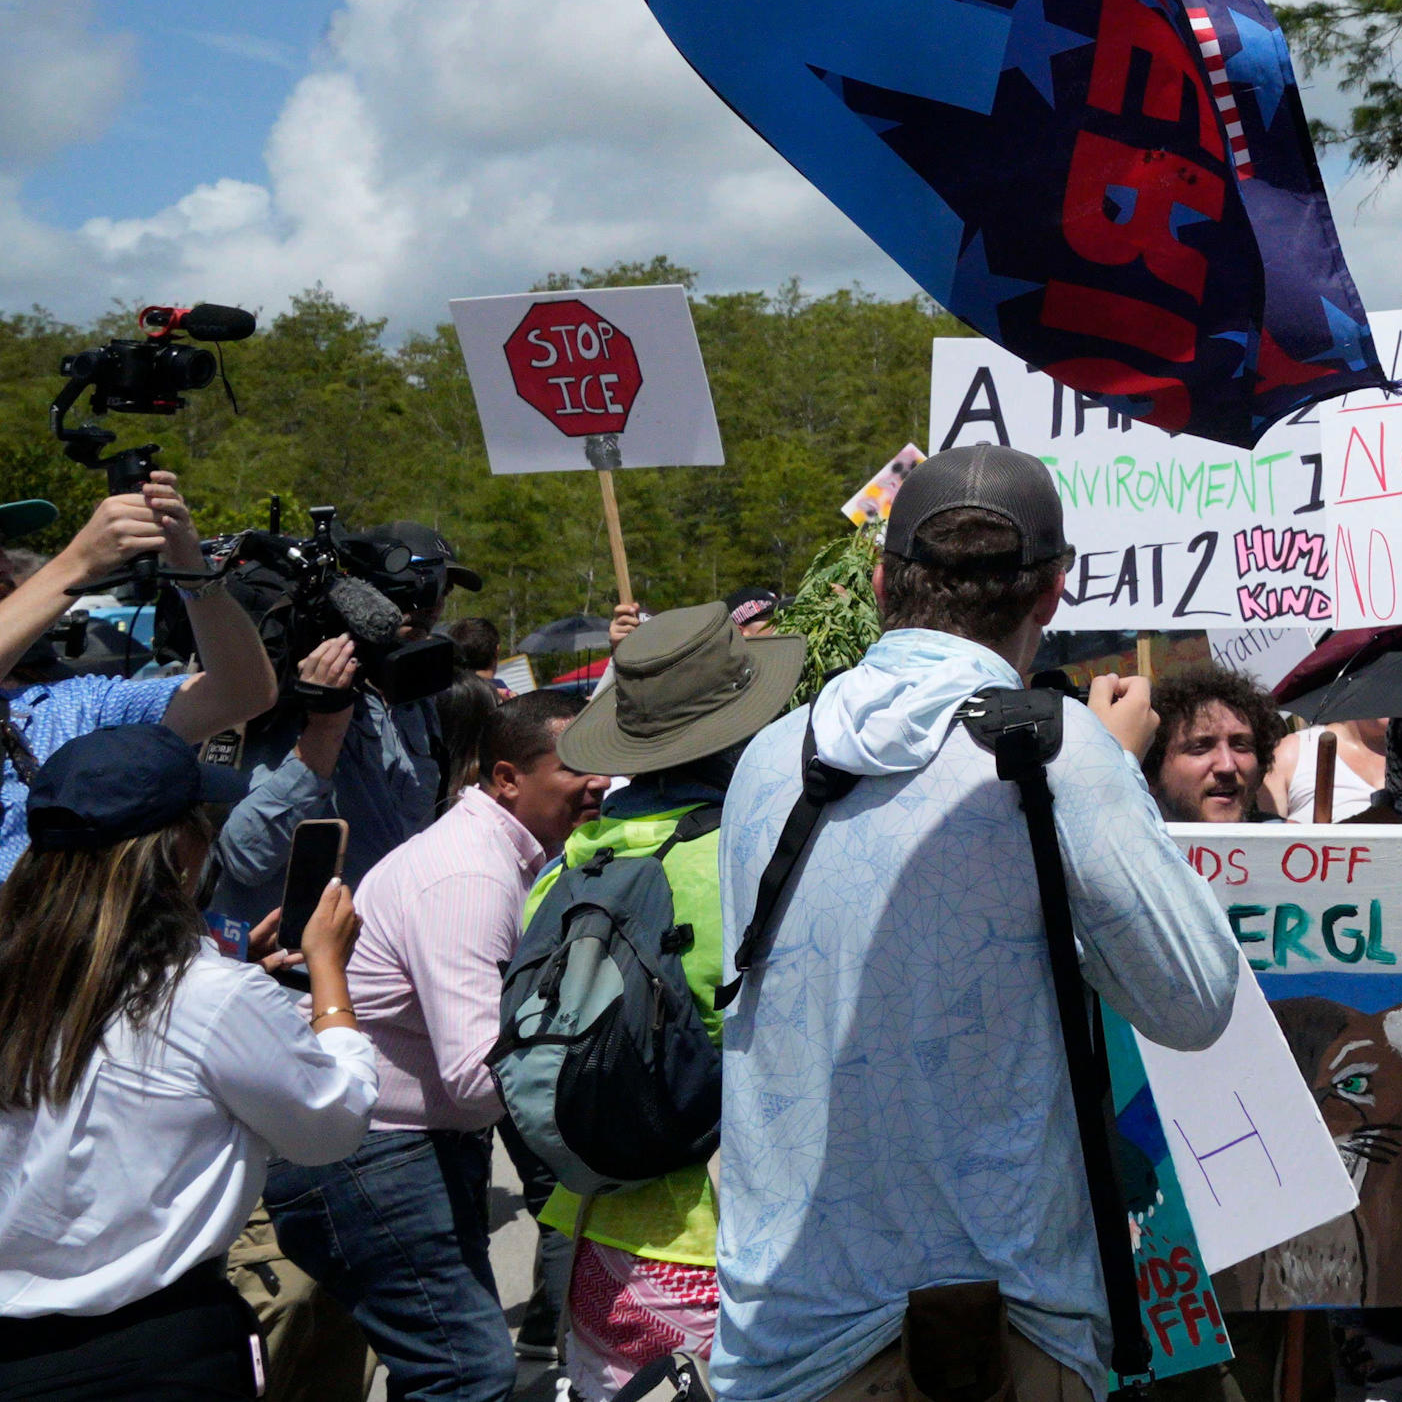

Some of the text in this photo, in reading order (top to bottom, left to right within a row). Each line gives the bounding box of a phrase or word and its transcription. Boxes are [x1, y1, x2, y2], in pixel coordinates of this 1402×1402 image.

[527, 321, 614, 368] STOP
[547, 373, 625, 415] ICE
[939, 366, 1012, 452] A
[1172, 530, 1232, 618] 2
[1335, 524, 1396, 628] NO
[1236, 581, 1333, 622] KIND
[1280, 842, 1372, 884] OFF
